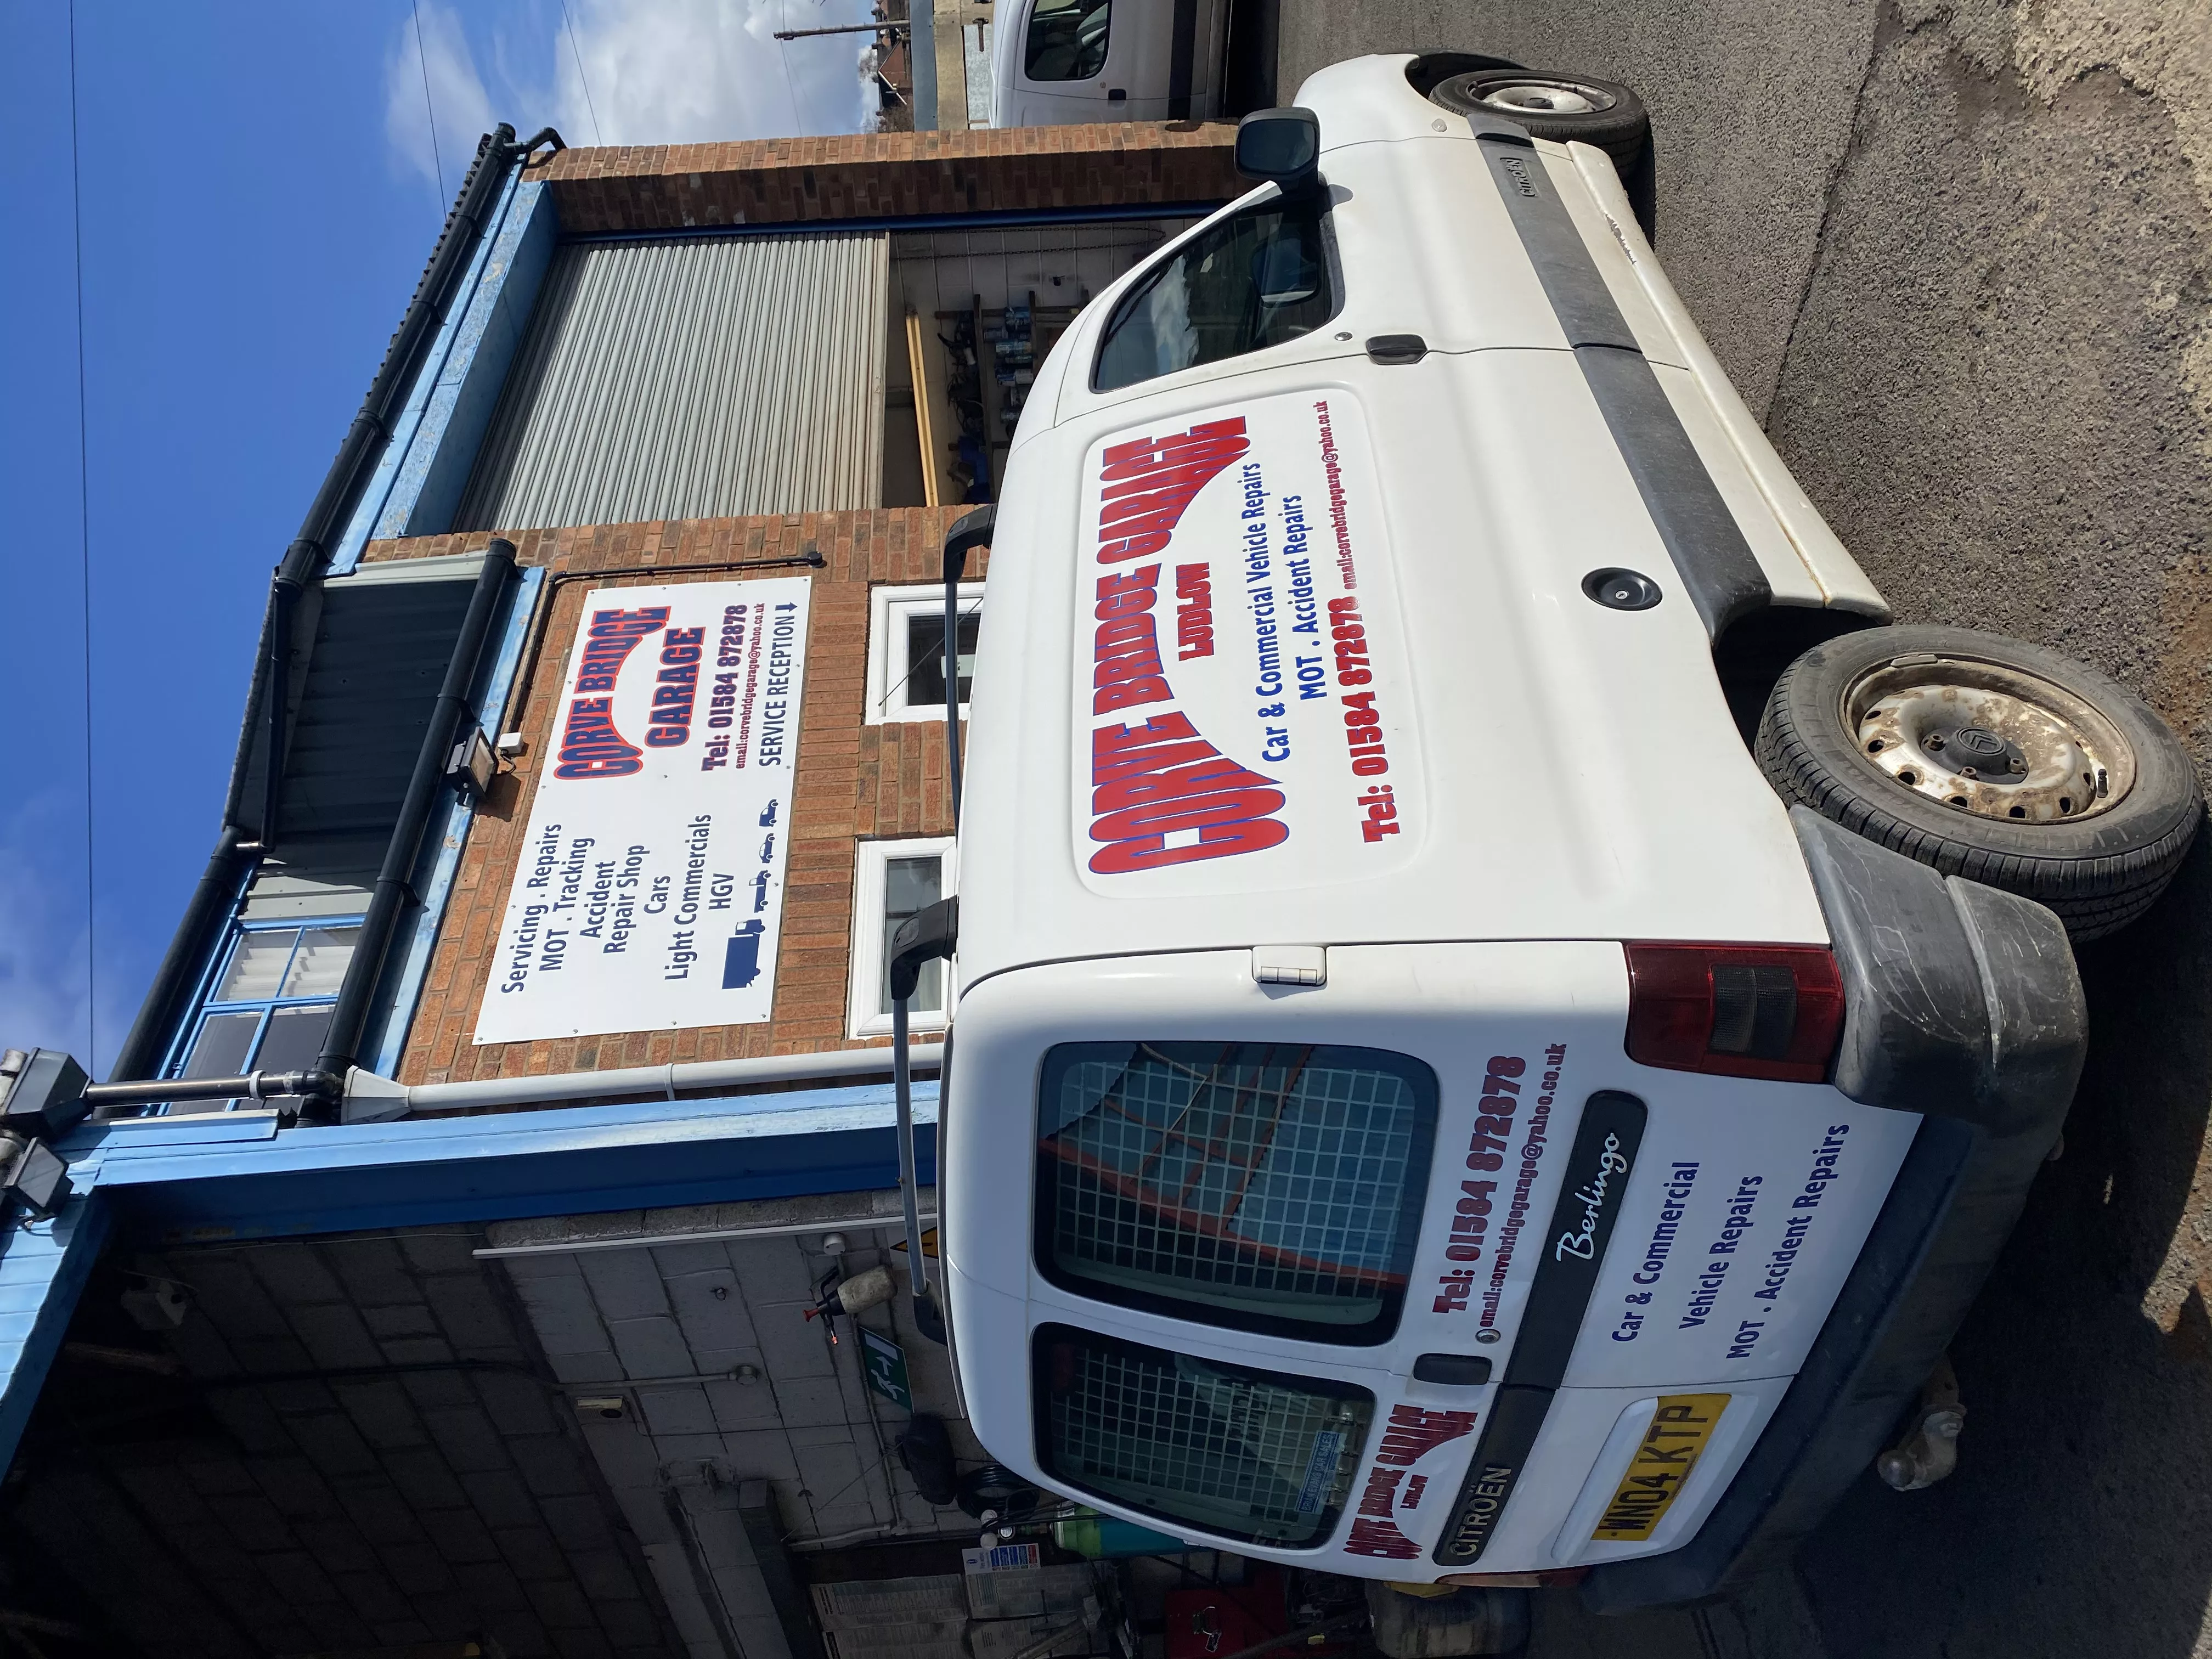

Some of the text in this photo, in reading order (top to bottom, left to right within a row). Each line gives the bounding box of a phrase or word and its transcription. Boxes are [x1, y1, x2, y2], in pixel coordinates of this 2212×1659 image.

[1500, 157, 1535, 197] CITROËN
[1278, 496, 1313, 555] Repairs
[1088, 416, 1290, 874] CORVE BRIDGE GARAGE
[1176, 562, 1214, 661] LUDLOW
[1237, 464, 1290, 761] Car & Commercial Vehicle Repairs
[1285, 558, 1318, 633] Accident
[1313, 401, 1400, 843] Tel: 01584 872878 email:corvebridgegarage@yahoo.co.uk
[554, 606, 671, 780] CORVE BRIDGE
[645, 627, 706, 748] GARAGE
[701, 605, 747, 771] Tel: 01584 872878
[736, 603, 764, 769] email:corvebridgegarage@yahoo.co.uk
[759, 616, 794, 766] SERVICE RECEPTION
[1295, 656, 1327, 700] MOT
[501, 905, 549, 993] Servicing
[527, 825, 561, 888] Repairs
[552, 838, 595, 912] Tracking
[580, 861, 616, 938] Accident
[603, 845, 650, 953] Repair Shop
[644, 876, 670, 913] Cars
[664, 815, 711, 980] Light Commercials
[709, 873, 733, 910] HGV
[539, 929, 569, 971] MOT
[1432, 1056, 1526, 1313] Tel: 01584 872878
[1479, 1043, 1567, 1327] email:corvebridgegarage@yahoo.co.uk
[1556, 1133, 1628, 1262] Berlingo
[1726, 1321, 1764, 1358] MOT
[1754, 1216, 1812, 1299] Accident
[1792, 1125, 1849, 1208] Repairs
[1612, 1163, 1699, 1341] Car & Commercial
[1679, 1176, 1763, 1329] Vehicle Repairs
[1307, 1472, 1322, 1492] EVANS
[1314, 1458, 1327, 1471] CAR
[1318, 1435, 1333, 1457] SALES
[1343, 1404, 1478, 1559] CORVE BRIDGE GARAGE
[1400, 1475, 1429, 1509] LUDLOW
[1597, 1406, 1708, 1530] WN04 KTP
[1449, 1467, 1512, 1556] CITROËN
